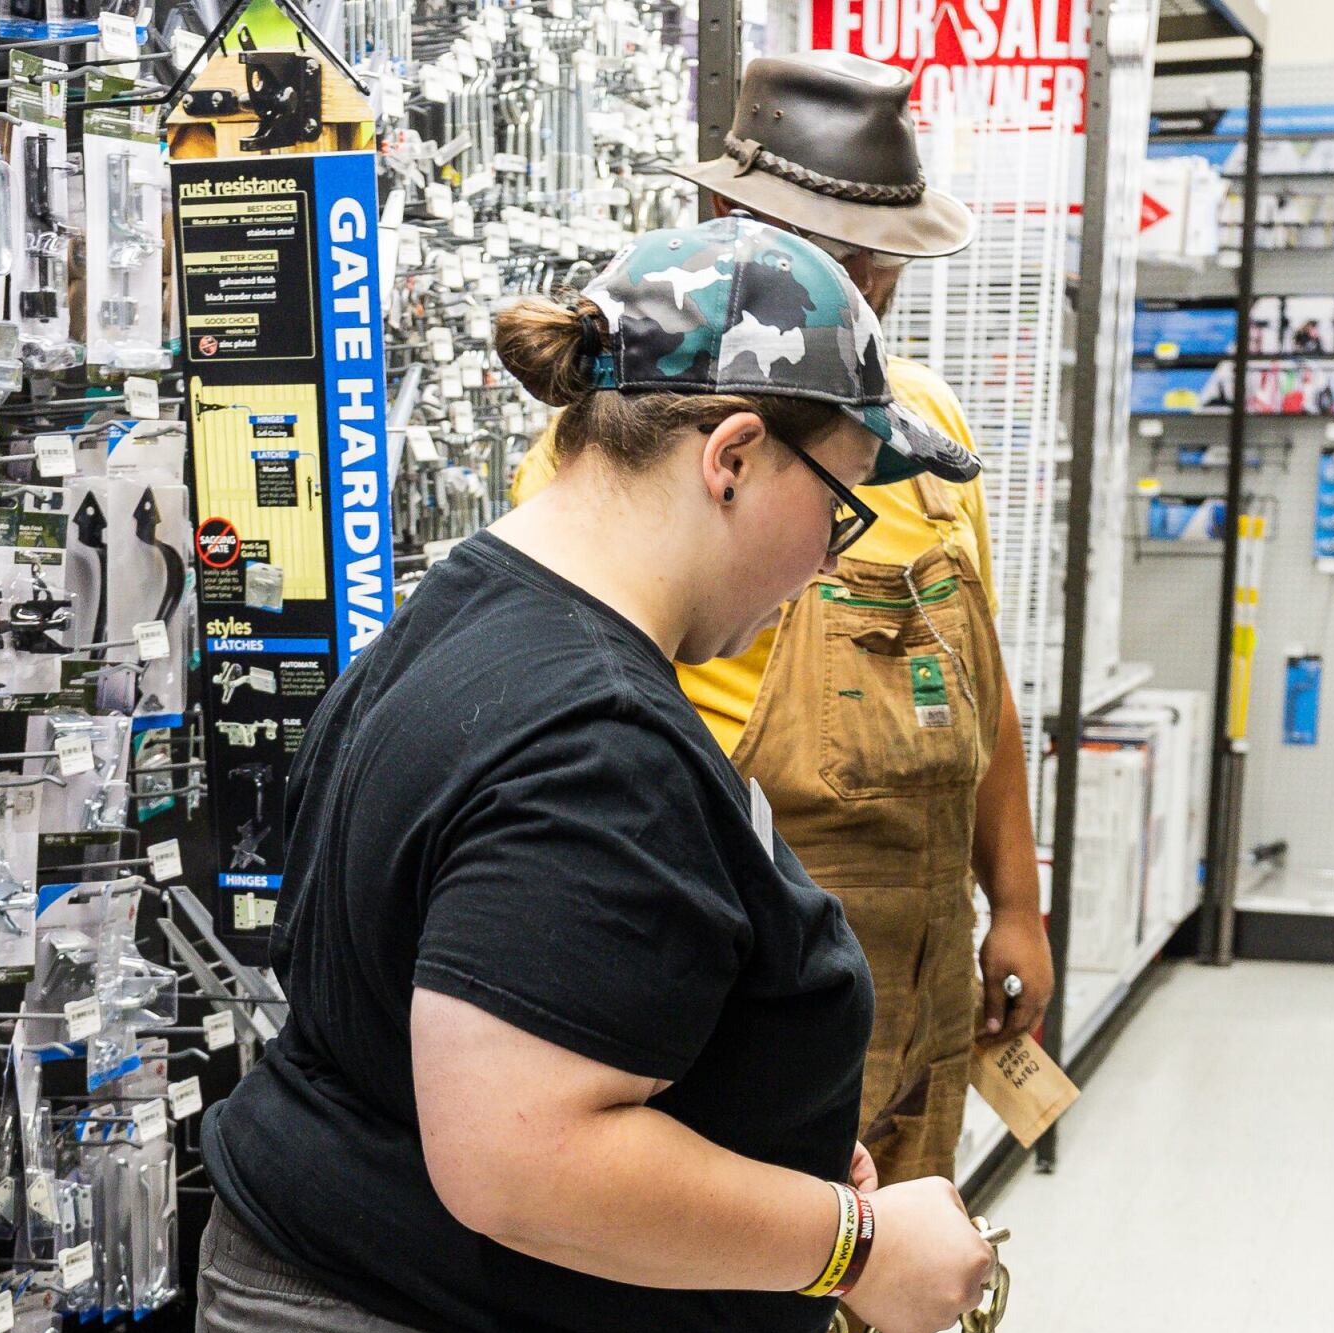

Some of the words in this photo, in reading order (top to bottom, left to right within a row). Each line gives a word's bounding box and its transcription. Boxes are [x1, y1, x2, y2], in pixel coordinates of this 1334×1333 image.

[832, 0, 936, 60] FOR
[961, 0, 1091, 60] SALE
[920, 64, 1085, 132] OWNER
[179, 178, 211, 197] rust
[217, 176, 296, 196] resistance
[247, 204, 264, 213] BEST
[266, 203, 293, 212] CHOICE
[220, 254, 245, 262] BETTER
[247, 253, 275, 261] CHOICE
[329, 197, 372, 362] GATE
[205, 317, 227, 325] GOOD
[229, 316, 255, 324] CHOICE
[337, 378, 384, 661] HARDWA
[200, 536, 236, 545] SAGGING
[207, 545, 229, 553] GATE
[206, 616, 252, 639] styles
[214, 640, 264, 651] LATCHES
[226, 875, 268, 886] HINGES
[841, 1227, 855, 1259] WORK
